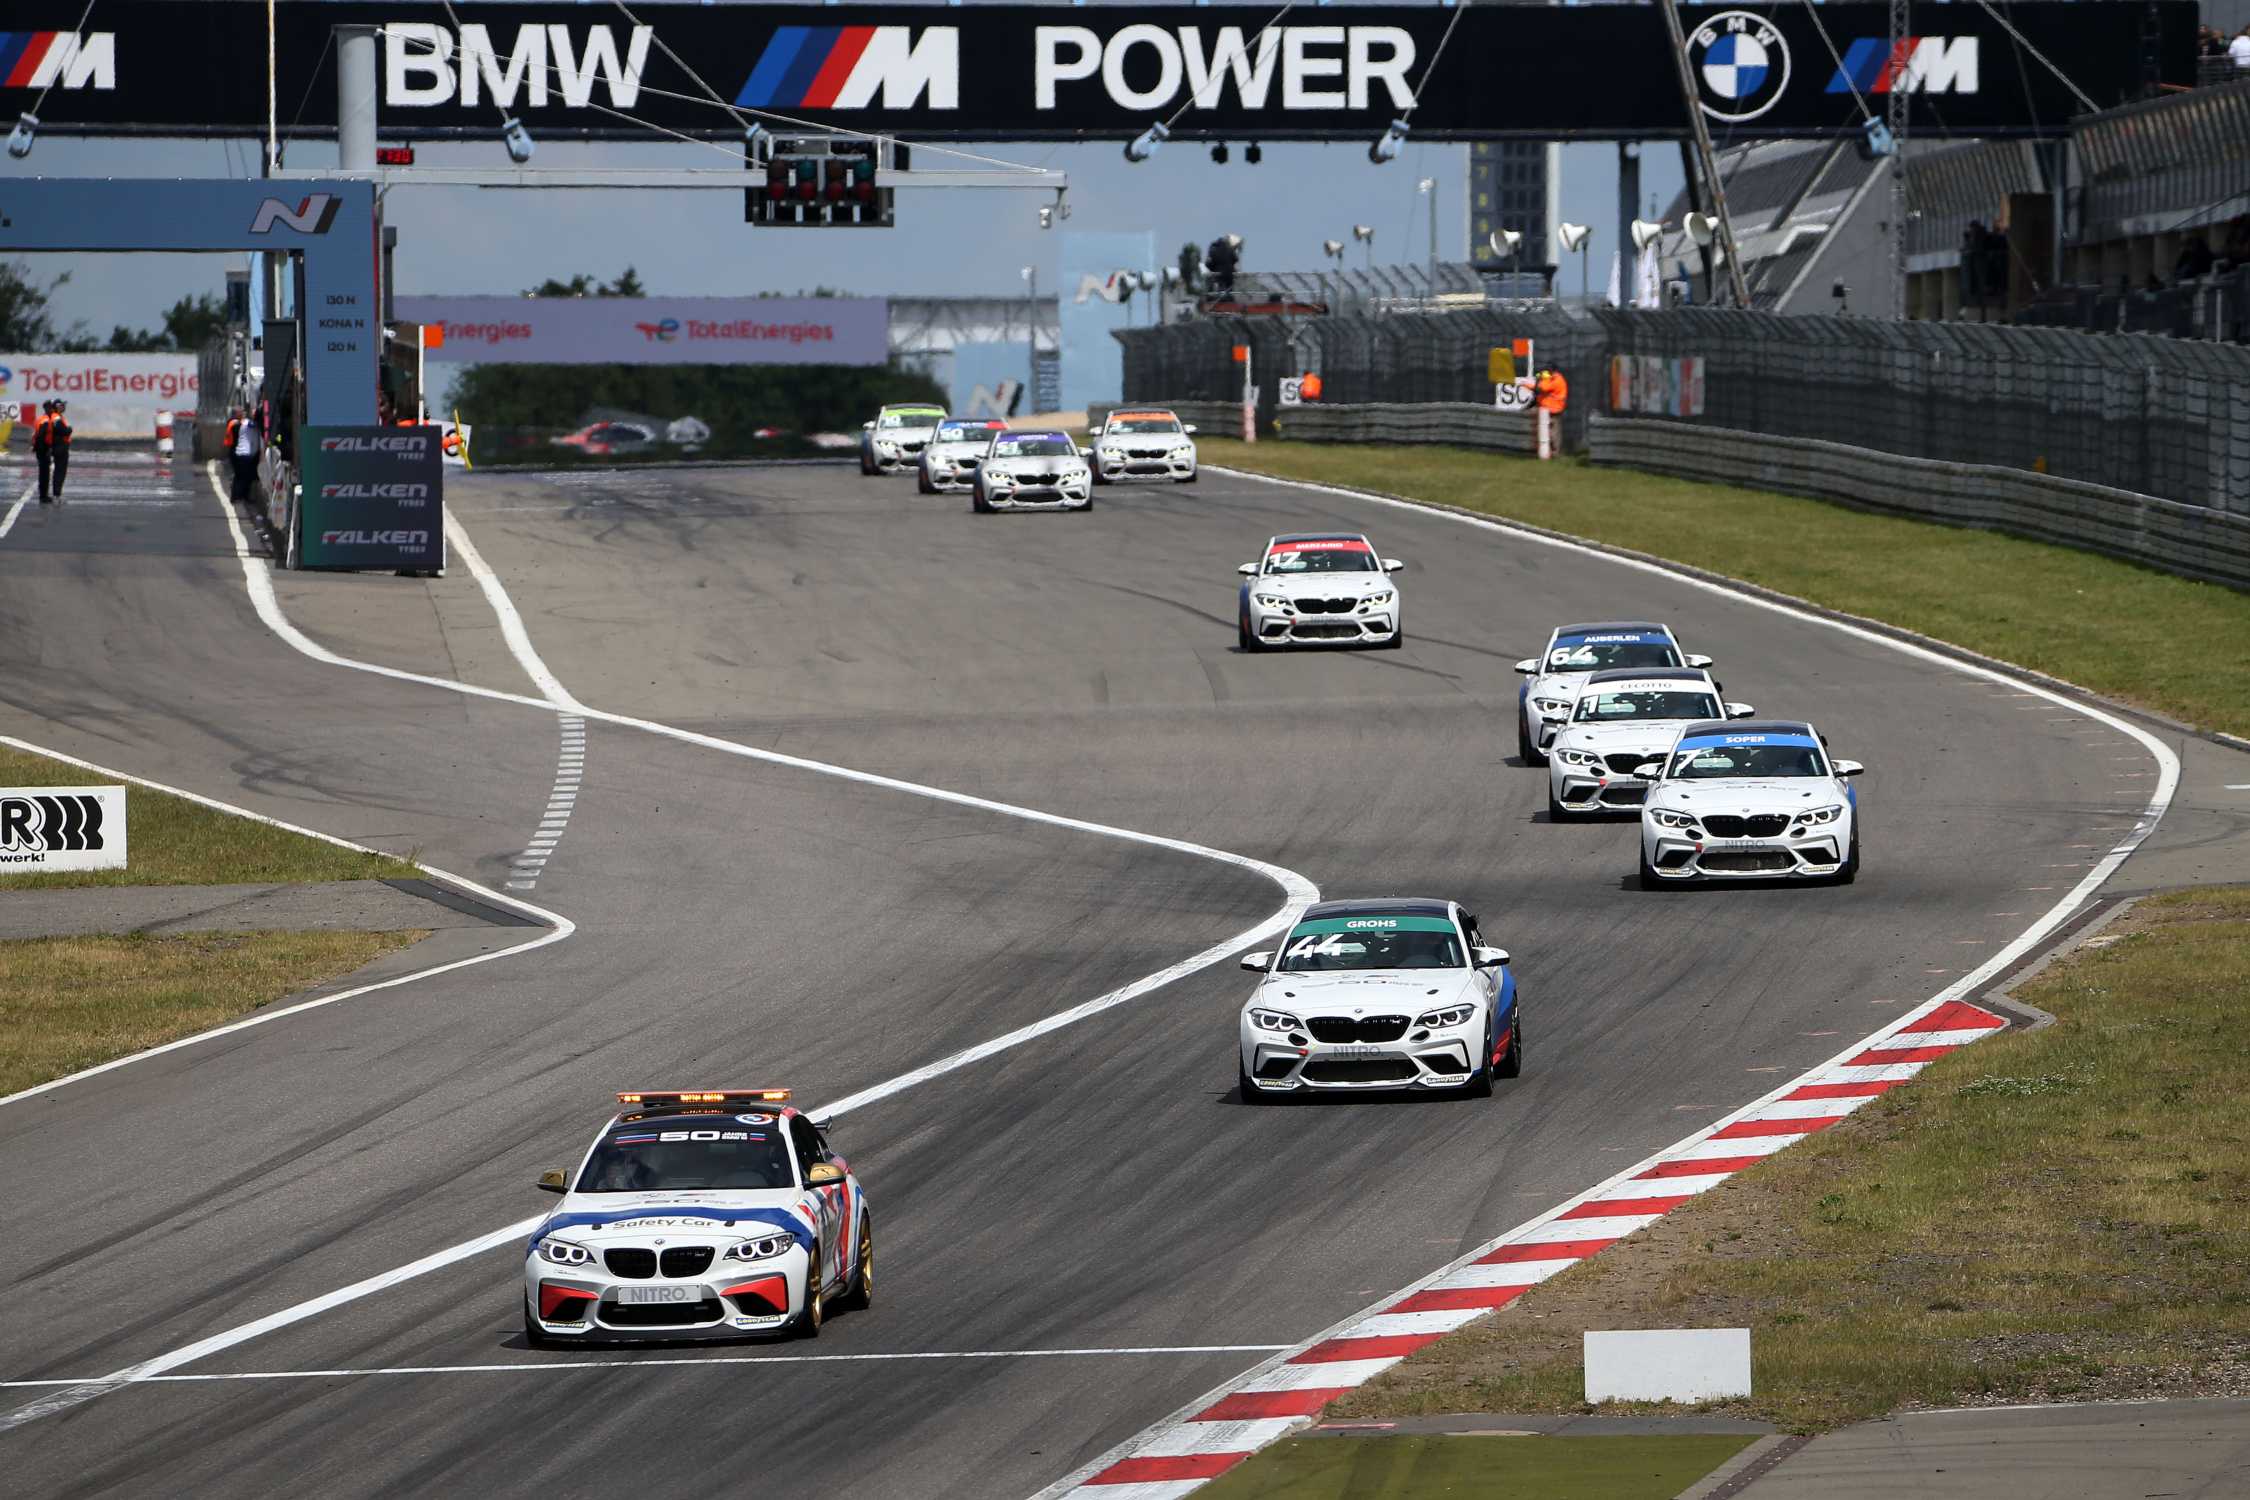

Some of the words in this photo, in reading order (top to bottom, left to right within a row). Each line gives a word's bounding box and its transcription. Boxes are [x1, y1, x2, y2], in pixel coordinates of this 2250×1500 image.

[1697, 17, 1777, 48] BMW
[28, 32, 116, 89] M
[385, 22, 655, 107] BMW
[1034, 24, 1418, 111] POWER
[1891, 36, 1979, 94] M
[346, 295, 356, 305] N
[319, 319, 353, 329] KONA
[354, 319, 365, 329] N
[686, 319, 834, 344] TotalEnergies
[346, 341, 357, 352] N
[321, 436, 427, 451] FALKEN
[322, 483, 428, 498] FALKEN
[322, 530, 429, 545] FALKEN
[1549, 645, 1593, 666] 64
[1725, 736, 1766, 744] SOPER
[1346, 919, 1397, 928] GROHS
[1286, 933, 1345, 959] 44
[659, 1130, 720, 1142] 50
[612, 1218, 676, 1230] Safety
[681, 1217, 716, 1228] Car
